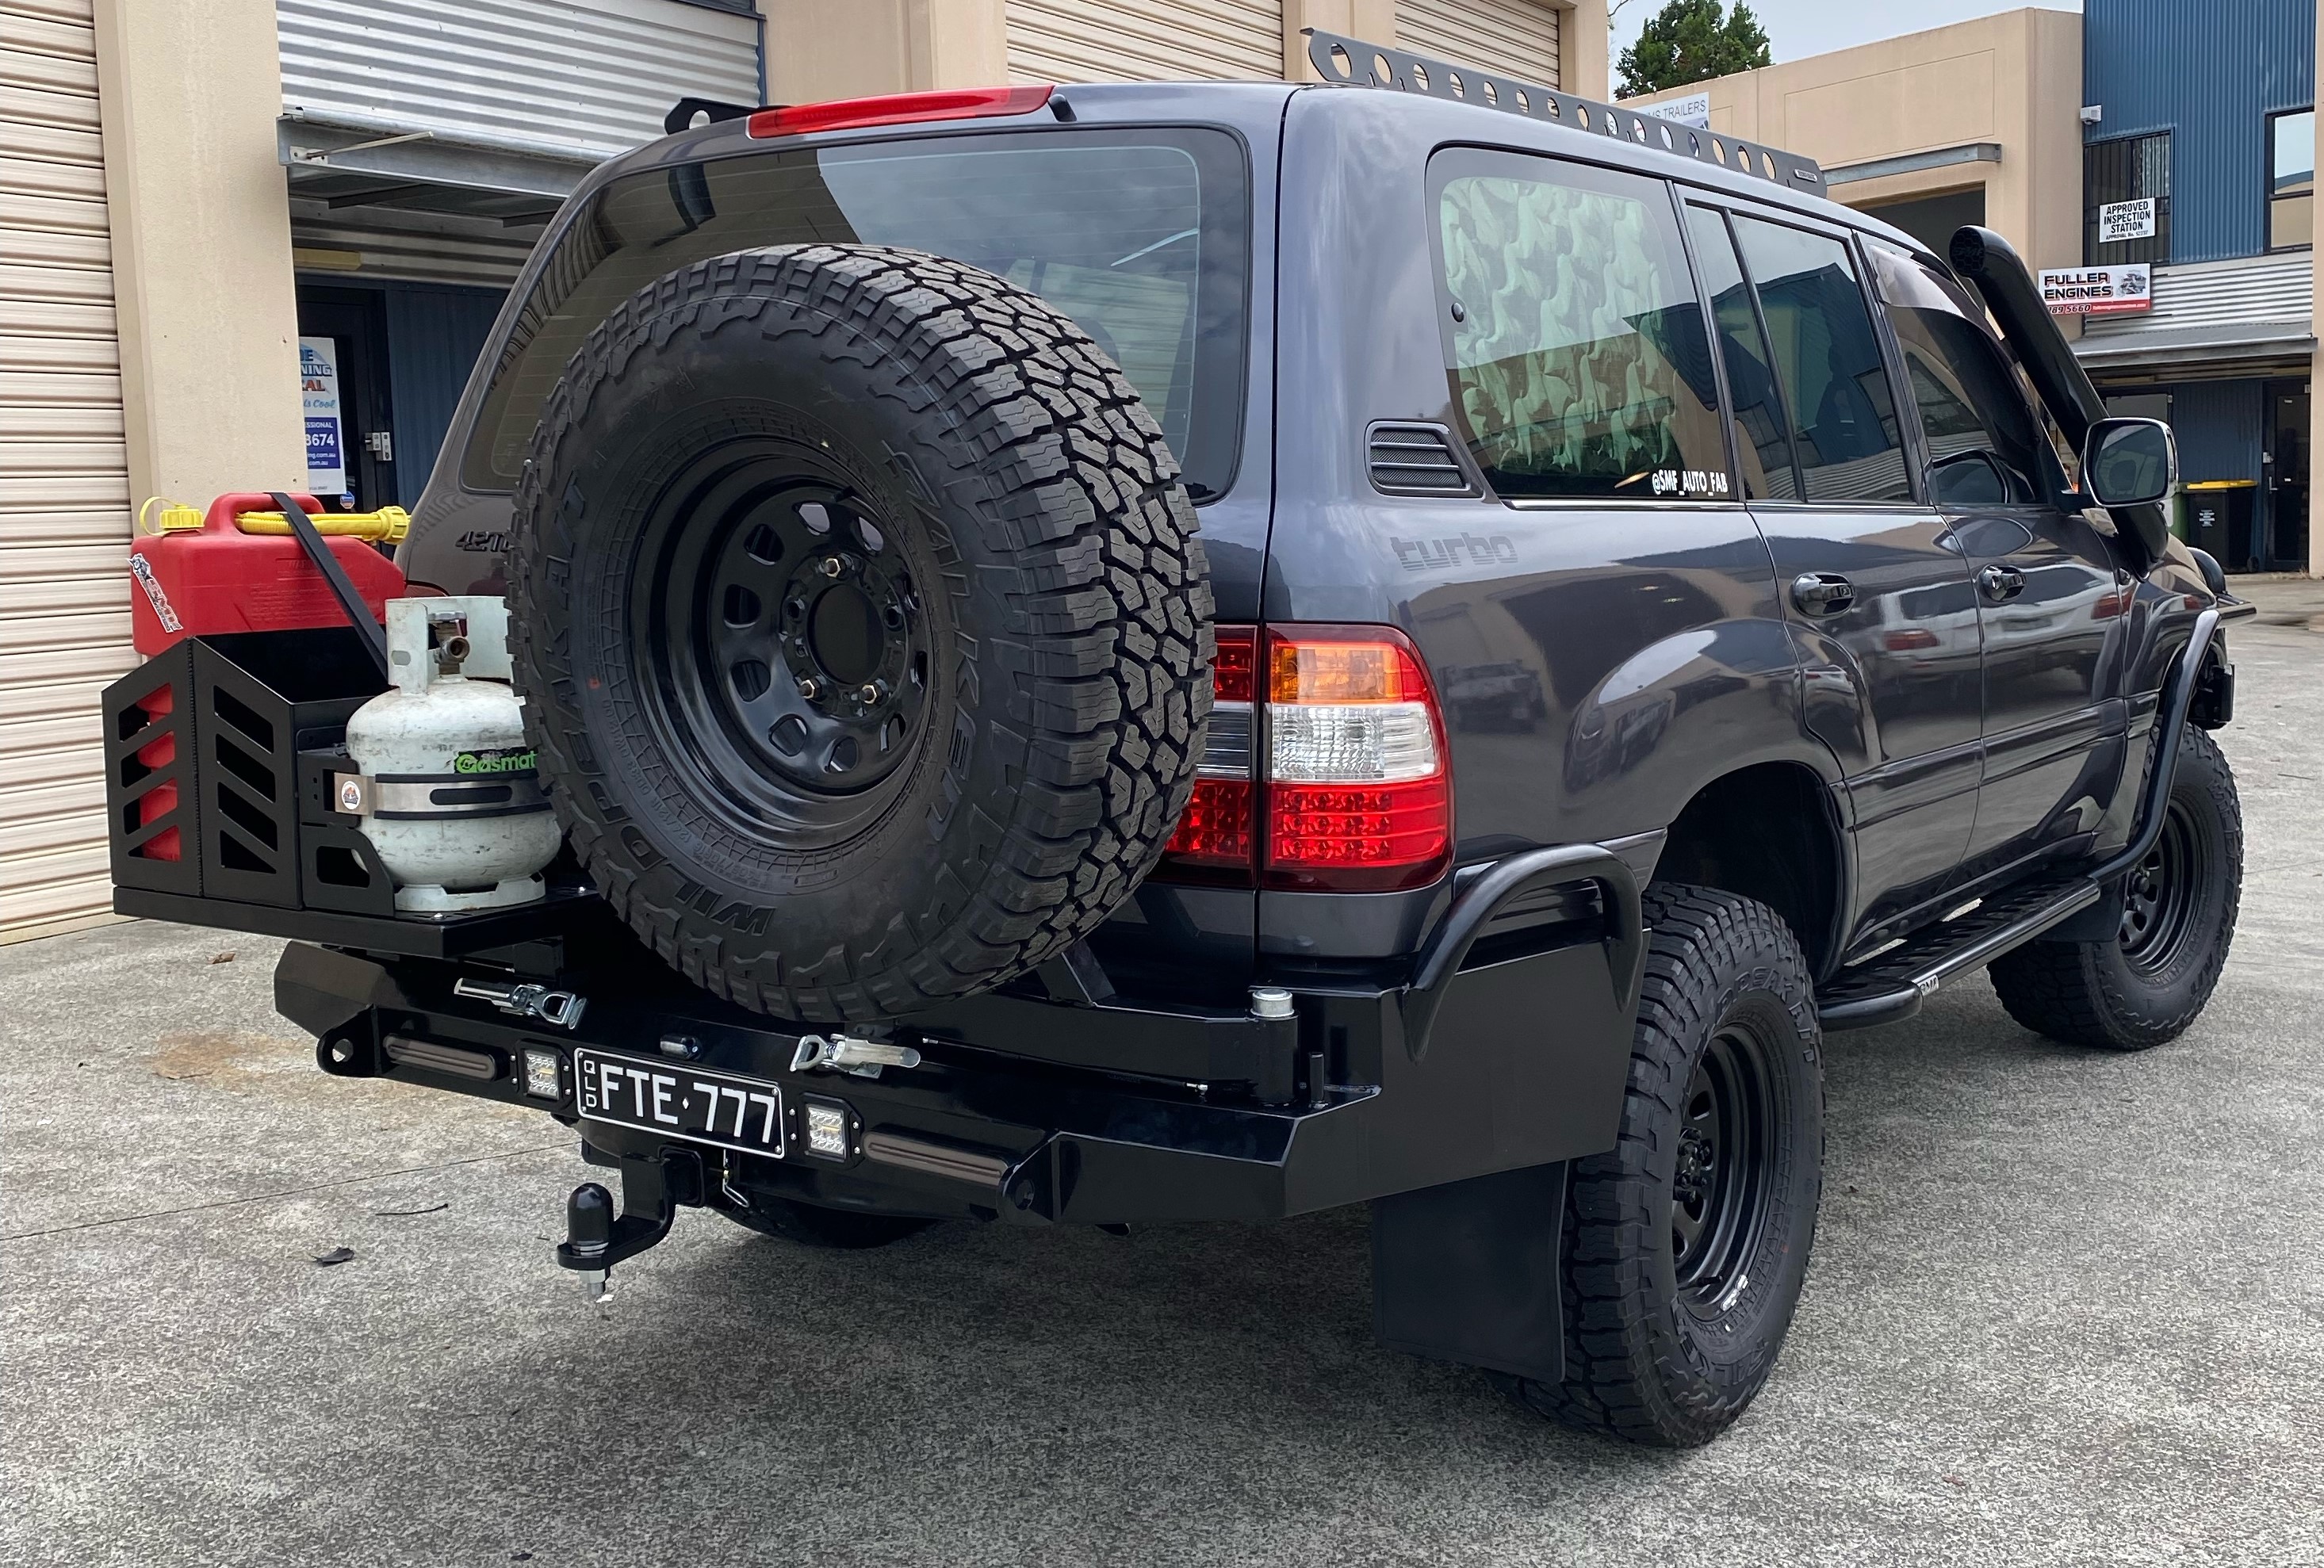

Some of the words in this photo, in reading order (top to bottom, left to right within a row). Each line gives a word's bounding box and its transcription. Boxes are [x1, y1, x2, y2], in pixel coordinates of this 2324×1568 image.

[1663, 99, 1706, 120] TRAILERS
[2106, 201, 2149, 215] APPROVED
[2104, 210, 2151, 225] INSPECTION
[2111, 221, 2143, 234] STATION
[2044, 272, 2111, 288] FULLER
[2044, 285, 2114, 301] ENGINES
[2066, 304, 2091, 314] 5660
[302, 379, 325, 392] AL
[313, 399, 335, 408] Cool
[1652, 468, 1729, 496] @SMF_AUTO_FAB
[1389, 532, 1518, 572] turbo
